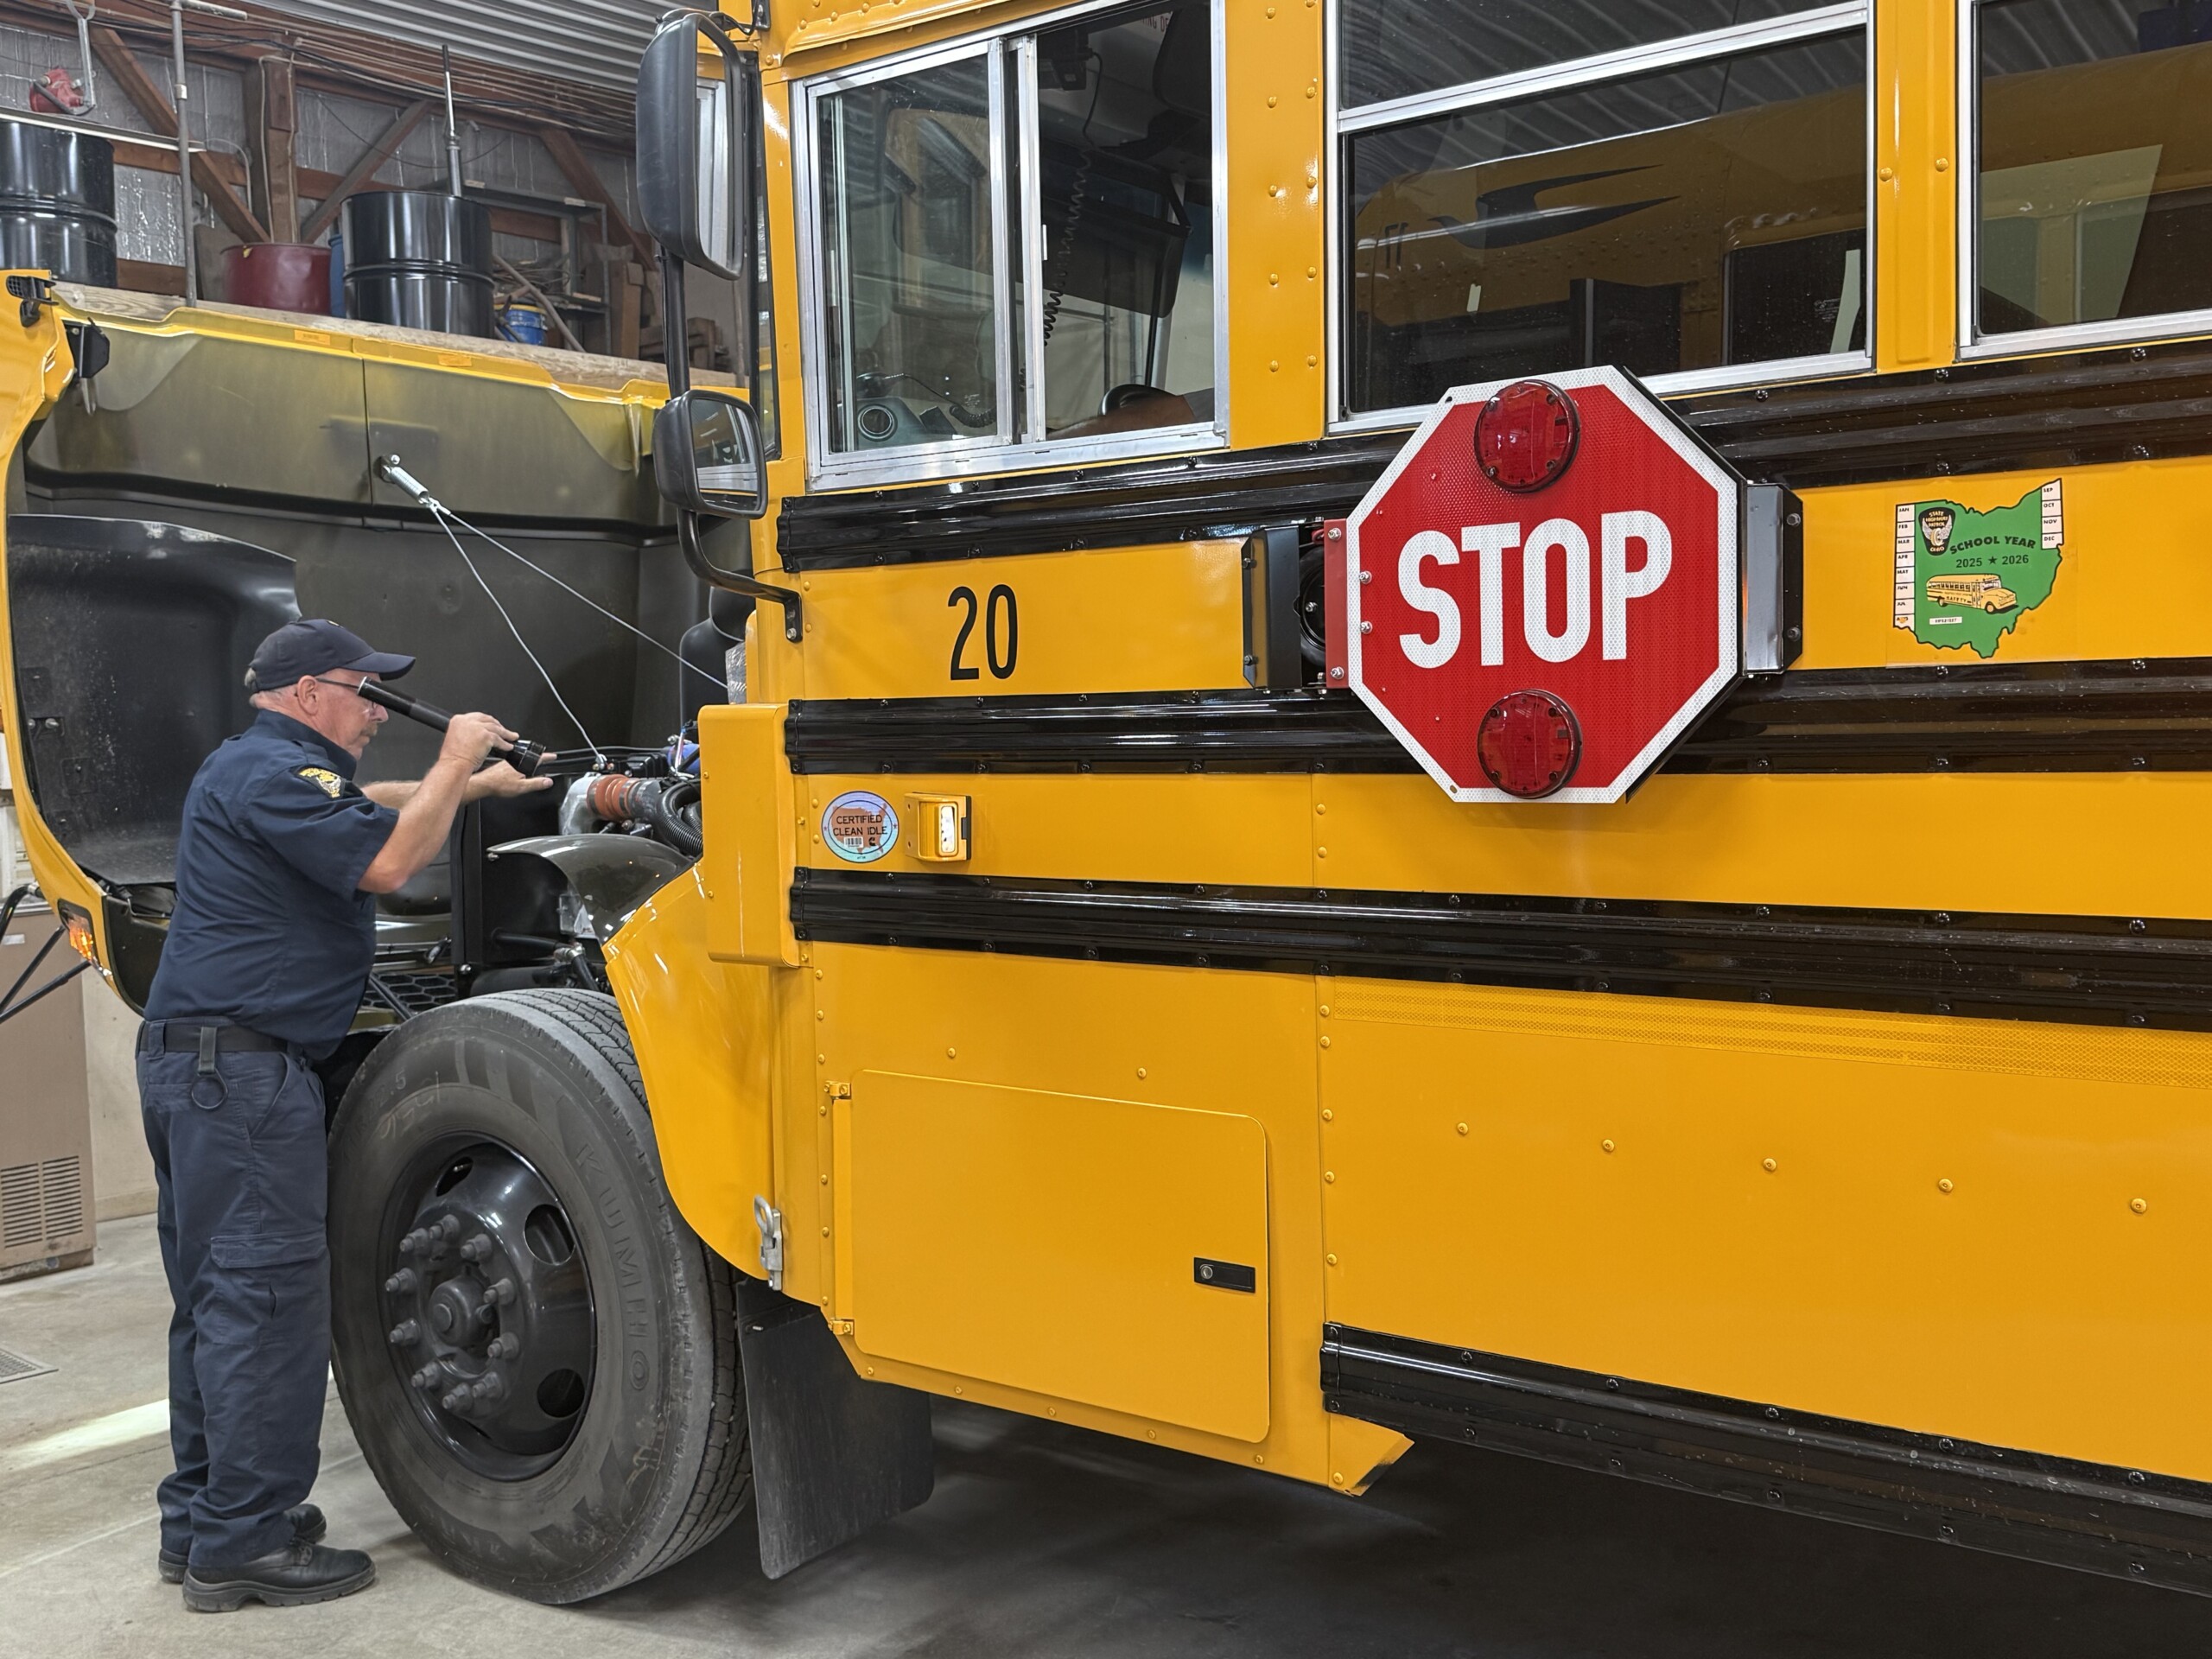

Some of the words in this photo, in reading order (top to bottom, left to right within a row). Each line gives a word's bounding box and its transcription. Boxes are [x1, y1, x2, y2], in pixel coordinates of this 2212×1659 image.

[1950, 537, 1999, 555] SCHOOL
[2005, 536, 2036, 549] YEAR
[1956, 557, 1982, 568] 2025
[2002, 555, 2029, 565] 2026
[1398, 510, 1672, 669] STOP
[948, 584, 1018, 680] 20
[836, 815, 882, 824] CERTIFIED
[833, 827, 863, 836] CLEAN
[868, 826, 887, 835] IDLE
[575, 1142, 651, 1392] KUMHO
